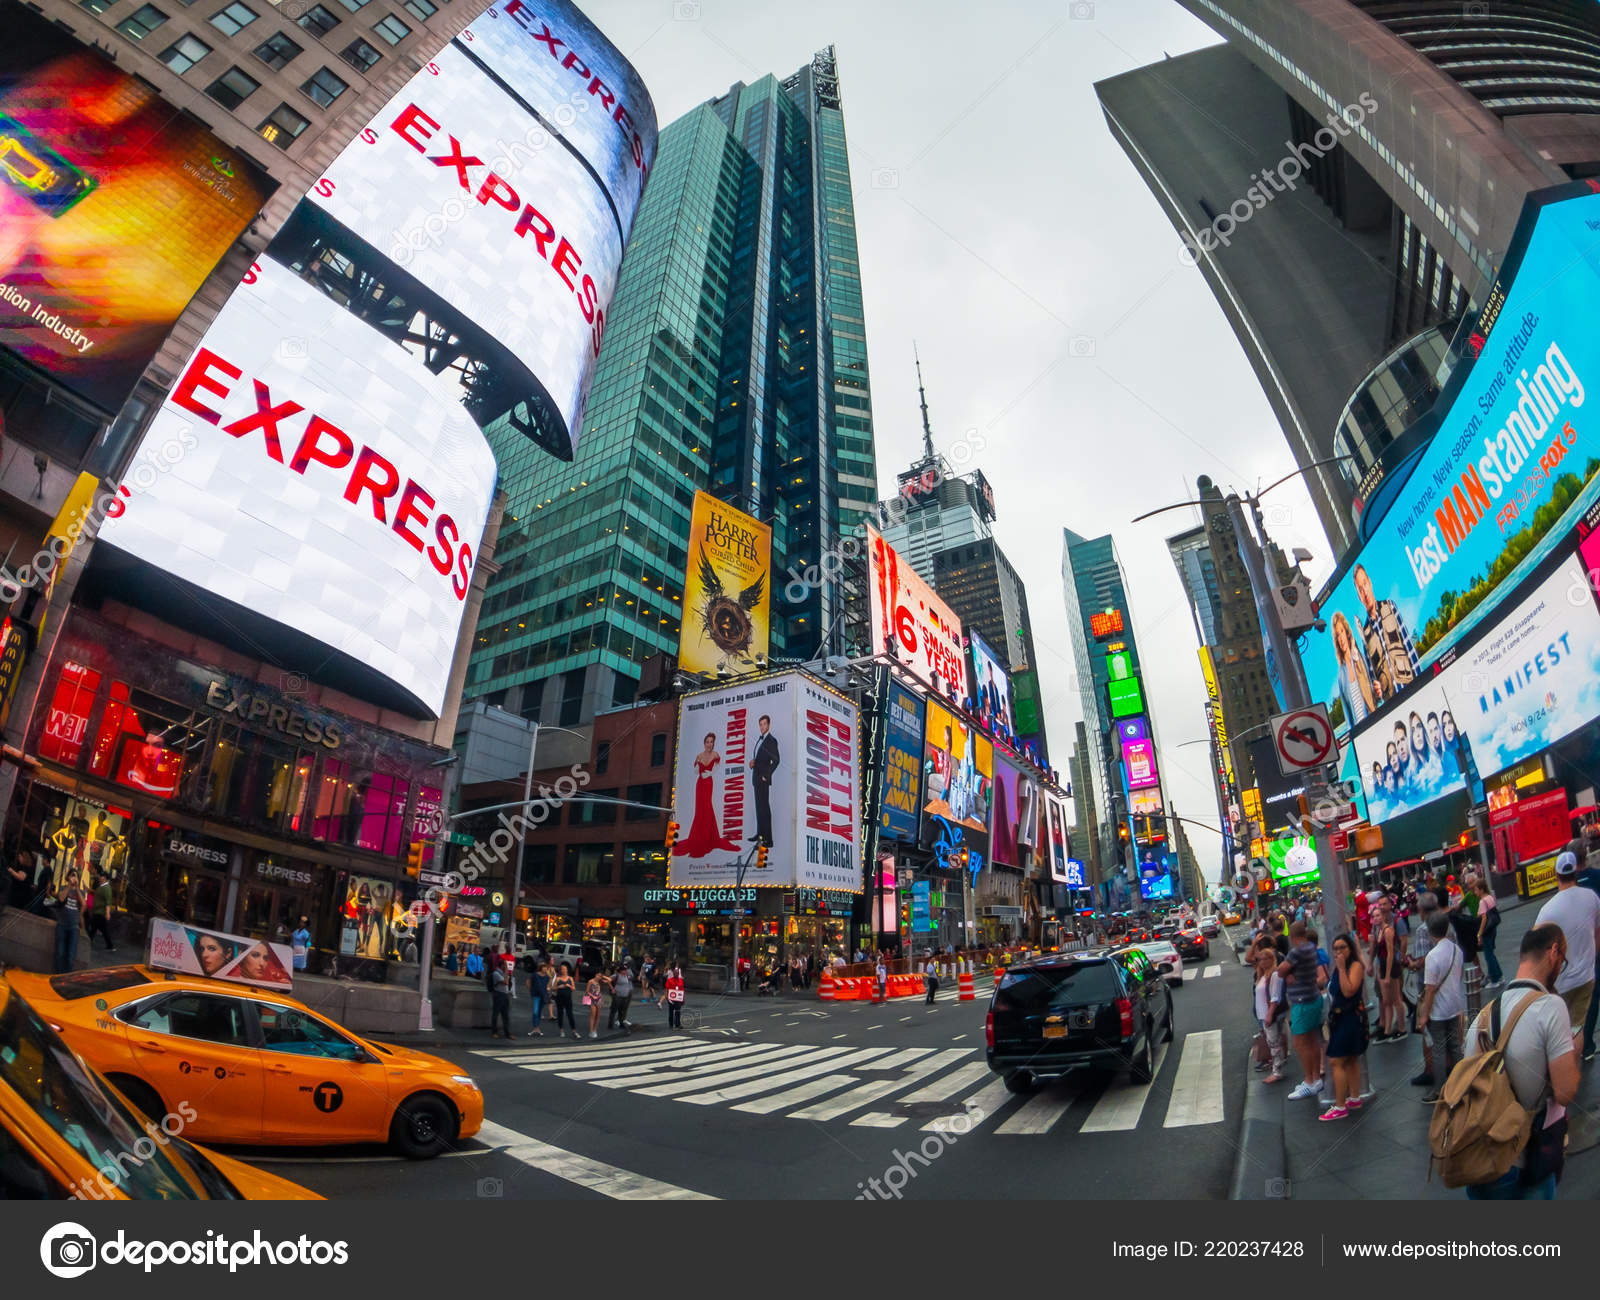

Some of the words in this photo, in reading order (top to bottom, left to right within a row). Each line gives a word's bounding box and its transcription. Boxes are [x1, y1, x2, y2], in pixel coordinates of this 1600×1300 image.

[390, 102, 604, 359] EXPRESS
[1478, 280, 1502, 328] MARRIOTT
[1483, 293, 1505, 336] MARQUIS
[32, 303, 95, 353] Industry
[1397, 511, 1415, 540] New
[1413, 486, 1436, 517] home.
[1433, 456, 1454, 489] New
[1452, 412, 1483, 462] season.
[1478, 369, 1508, 415] Same
[1503, 311, 1540, 375] attitude.
[170, 347, 473, 601] EXPRESS
[1405, 521, 1448, 590] last
[1434, 463, 1492, 555] MAN
[1479, 341, 1585, 499] standing
[1496, 497, 1521, 535] FRI
[1514, 467, 1545, 511] 9/28
[1538, 433, 1568, 478] FOX
[1562, 421, 1577, 445] 5
[705, 524, 760, 566] POTTER
[710, 511, 759, 548] HARRY
[922, 627, 958, 670] SMASH
[206, 680, 341, 749] EXPRESS
[724, 708, 747, 766] PRETTY
[806, 709, 830, 832] WOMAN
[828, 717, 854, 843] PRETTY
[888, 745, 920, 771] COME
[722, 775, 745, 841] WOMAN
[884, 789, 918, 814] AWAY
[169, 839, 229, 865] EXPRESS
[257, 862, 312, 884] EXPRESS
[806, 835, 820, 864] THE
[821, 837, 854, 870] MUSICAL
[643, 889, 680, 901] GIFTS
[690, 888, 757, 902] LUGGAGE
[800, 887, 816, 901] IFTS
[154, 937, 184, 951] SIMPLE
